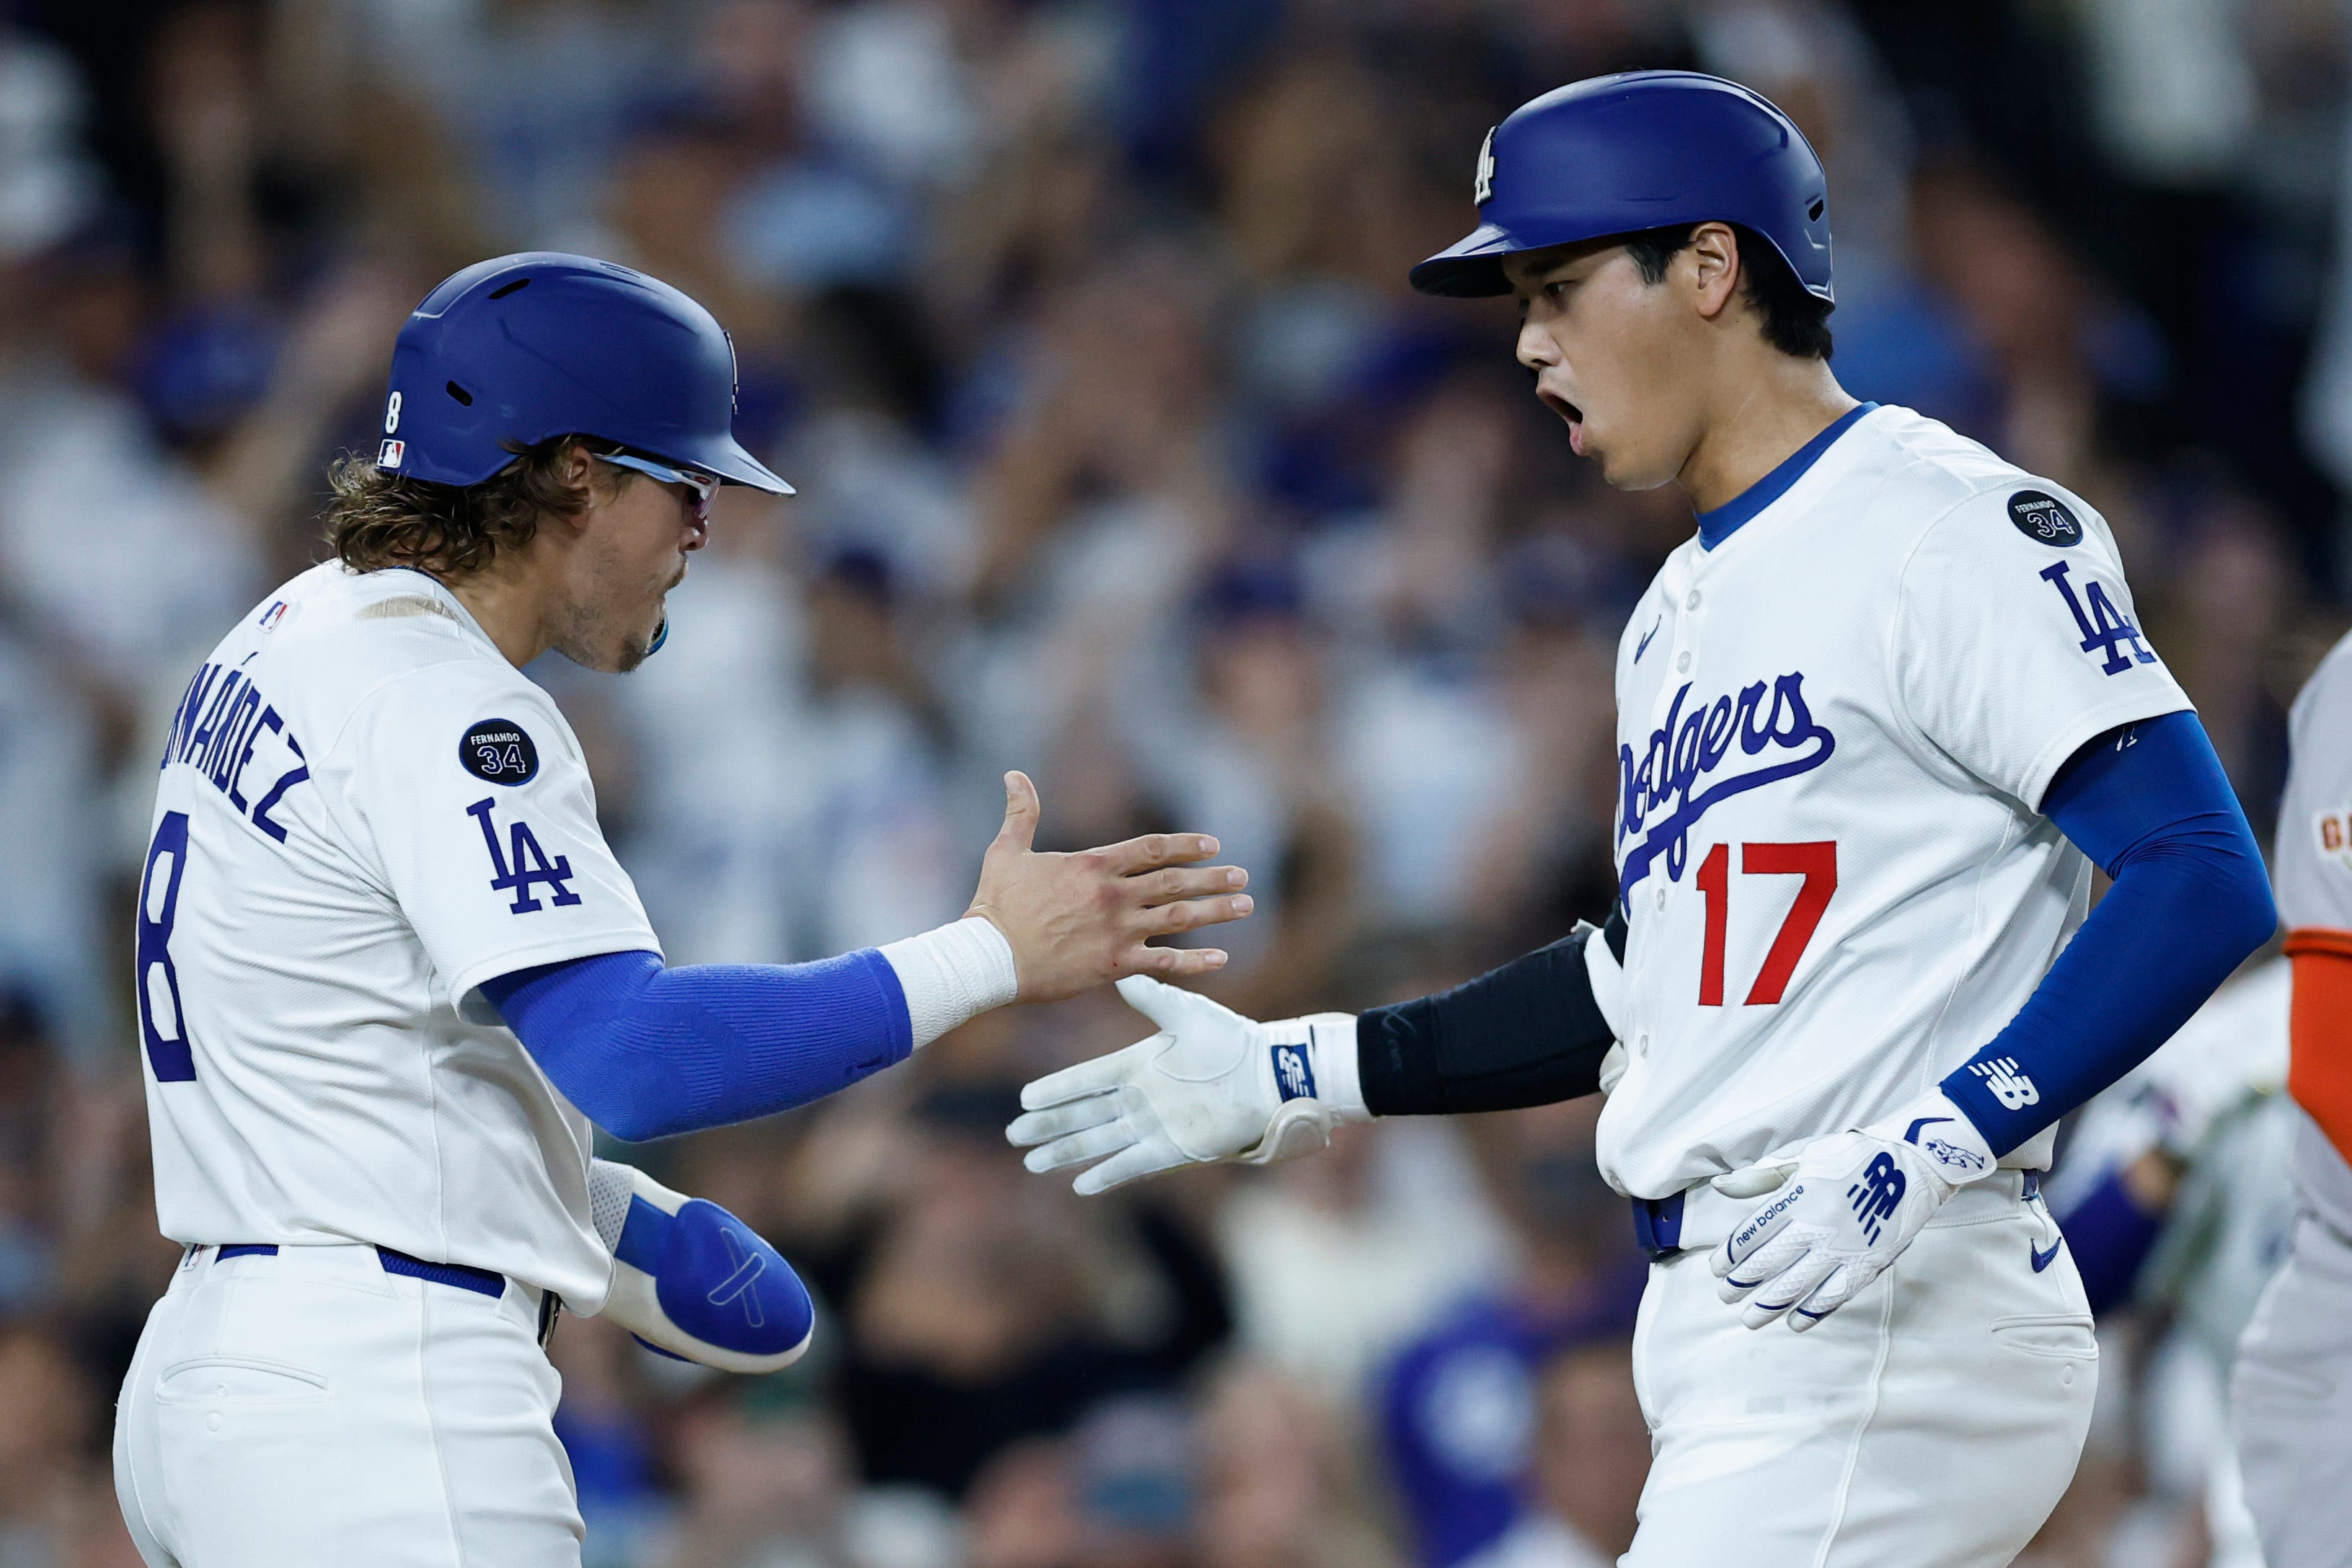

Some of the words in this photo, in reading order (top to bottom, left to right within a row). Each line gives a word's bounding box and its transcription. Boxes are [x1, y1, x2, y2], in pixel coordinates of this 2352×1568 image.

[386, 391, 402, 434] 8
[2014, 500, 2055, 514] FERNANDO
[2027, 509, 2075, 538] 34
[2039, 559, 2157, 676] LA
[470, 732, 521, 746] FERNANDO
[477, 743, 526, 774] 34
[466, 797, 583, 915] LA
[137, 810, 197, 1081] 8
[1696, 841, 1838, 1006] 17
[1736, 1223, 1757, 1246] new
[1755, 1185, 1804, 1227] balance
